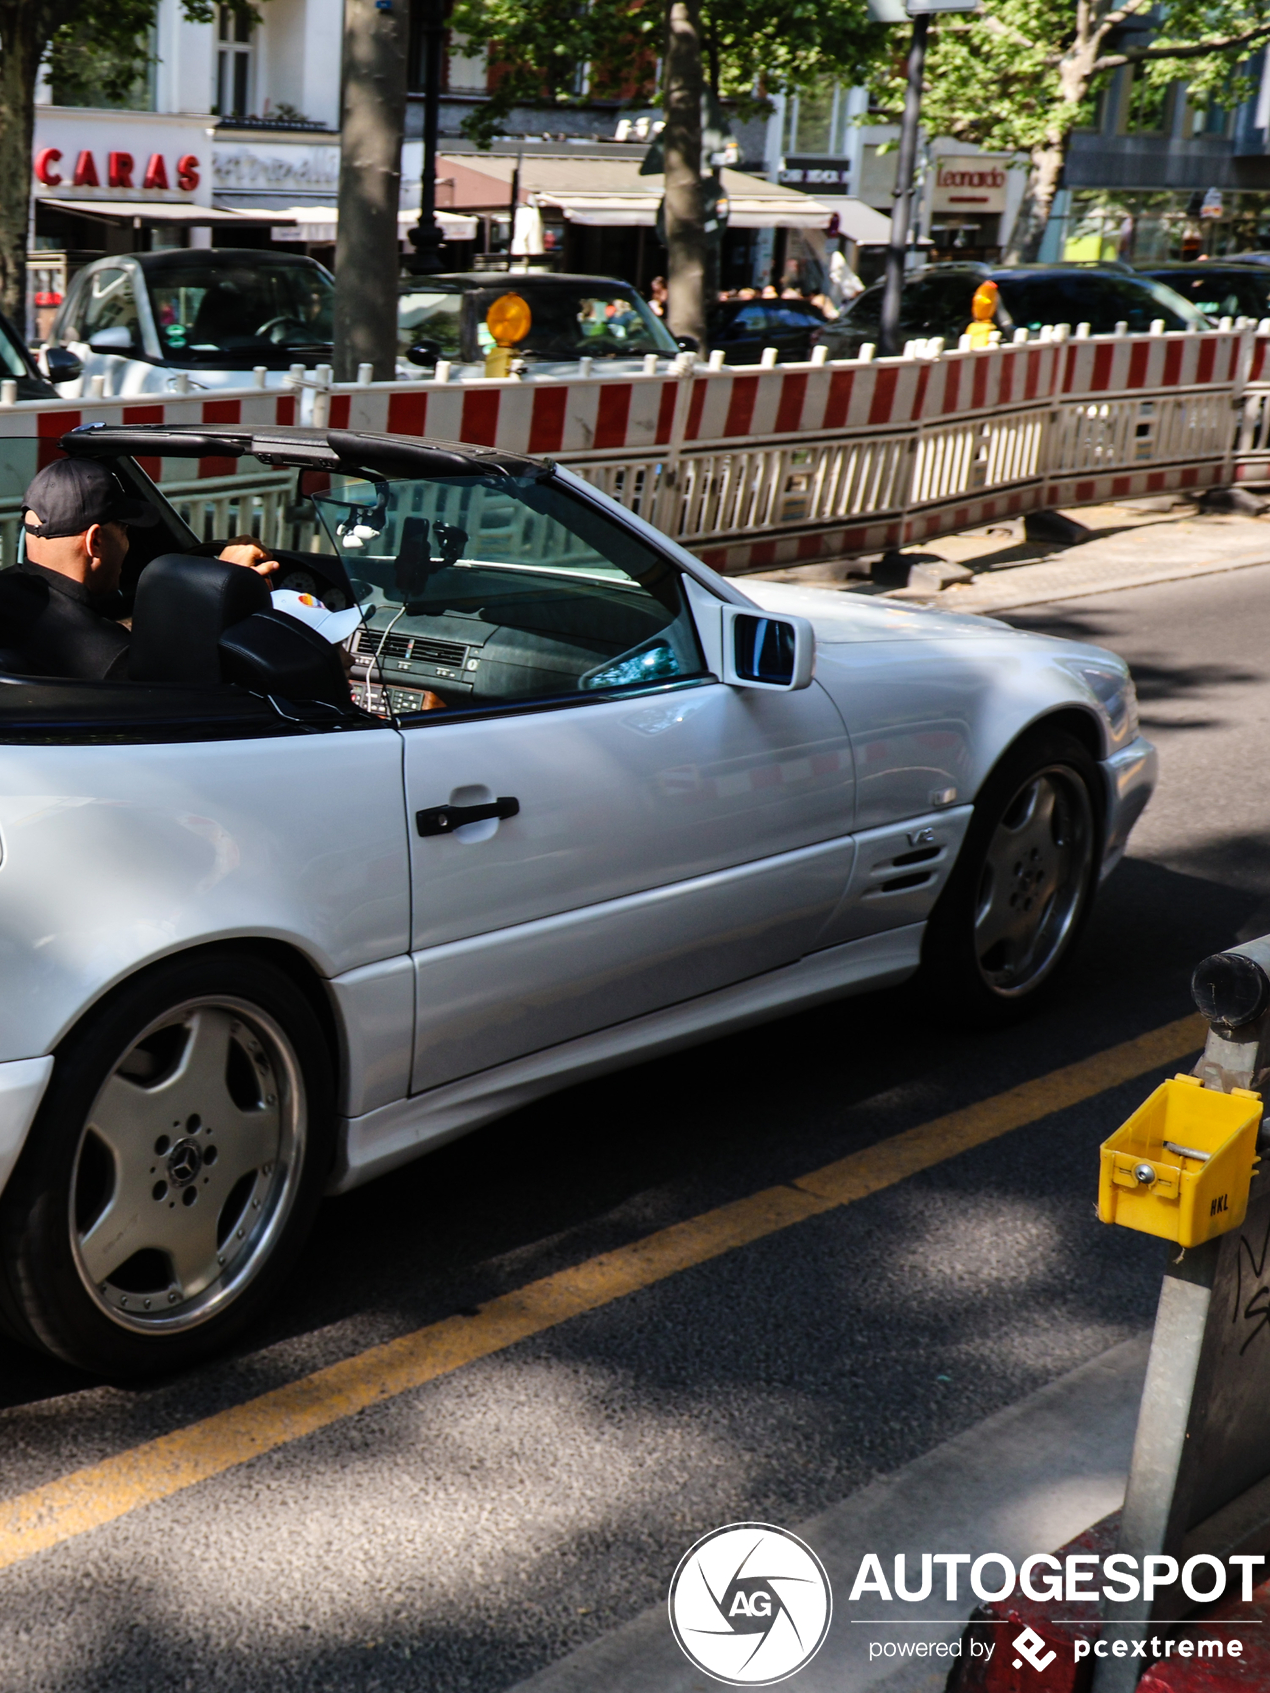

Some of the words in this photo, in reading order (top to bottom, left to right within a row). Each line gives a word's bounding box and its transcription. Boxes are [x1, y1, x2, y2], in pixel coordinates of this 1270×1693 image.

[34, 147, 200, 191] CARAS
[936, 165, 1006, 188] Leonardo
[1210, 1193, 1229, 1217] HKL
